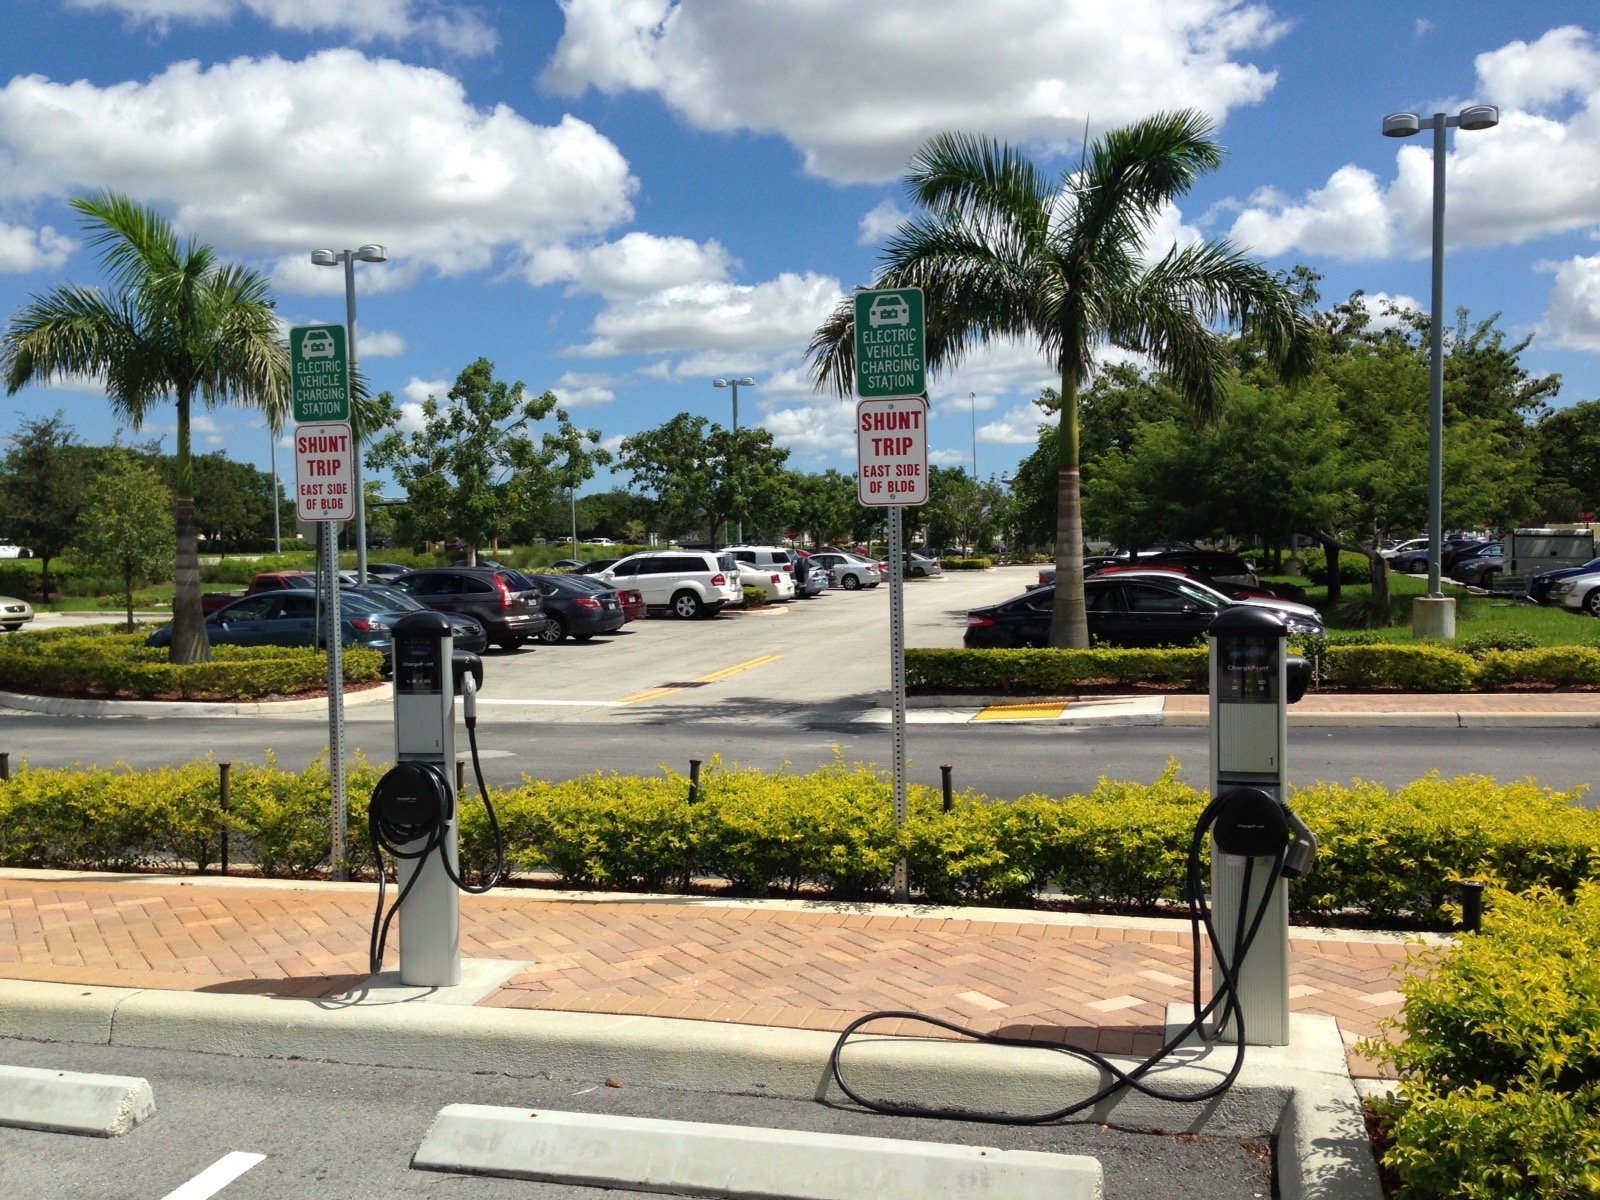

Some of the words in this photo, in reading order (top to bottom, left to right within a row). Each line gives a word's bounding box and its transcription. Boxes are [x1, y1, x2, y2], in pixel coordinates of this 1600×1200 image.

[863, 328, 916, 344] ELECTRIC
[866, 343, 914, 358] VEHICLE
[297, 360, 341, 374] ELECTRIC
[861, 358, 920, 374] CHARGING
[300, 374, 340, 387] VEHICLE
[868, 374, 914, 389] STATION
[296, 387, 345, 401] CHARGING
[302, 401, 340, 415] STATION
[861, 411, 922, 431] SHUNT
[298, 436, 347, 453] SHUNT
[871, 437, 913, 456] TRIP
[307, 459, 341, 476] TRIP
[863, 465, 891, 477] EAST
[896, 464, 920, 476] SIDE
[301, 484, 323, 495] EAST
[327, 483, 347, 494] SIDE
[870, 481, 882, 493] OF
[888, 480, 915, 492] BLDG
[306, 499, 317, 510] OF
[321, 498, 343, 509] BLDG
